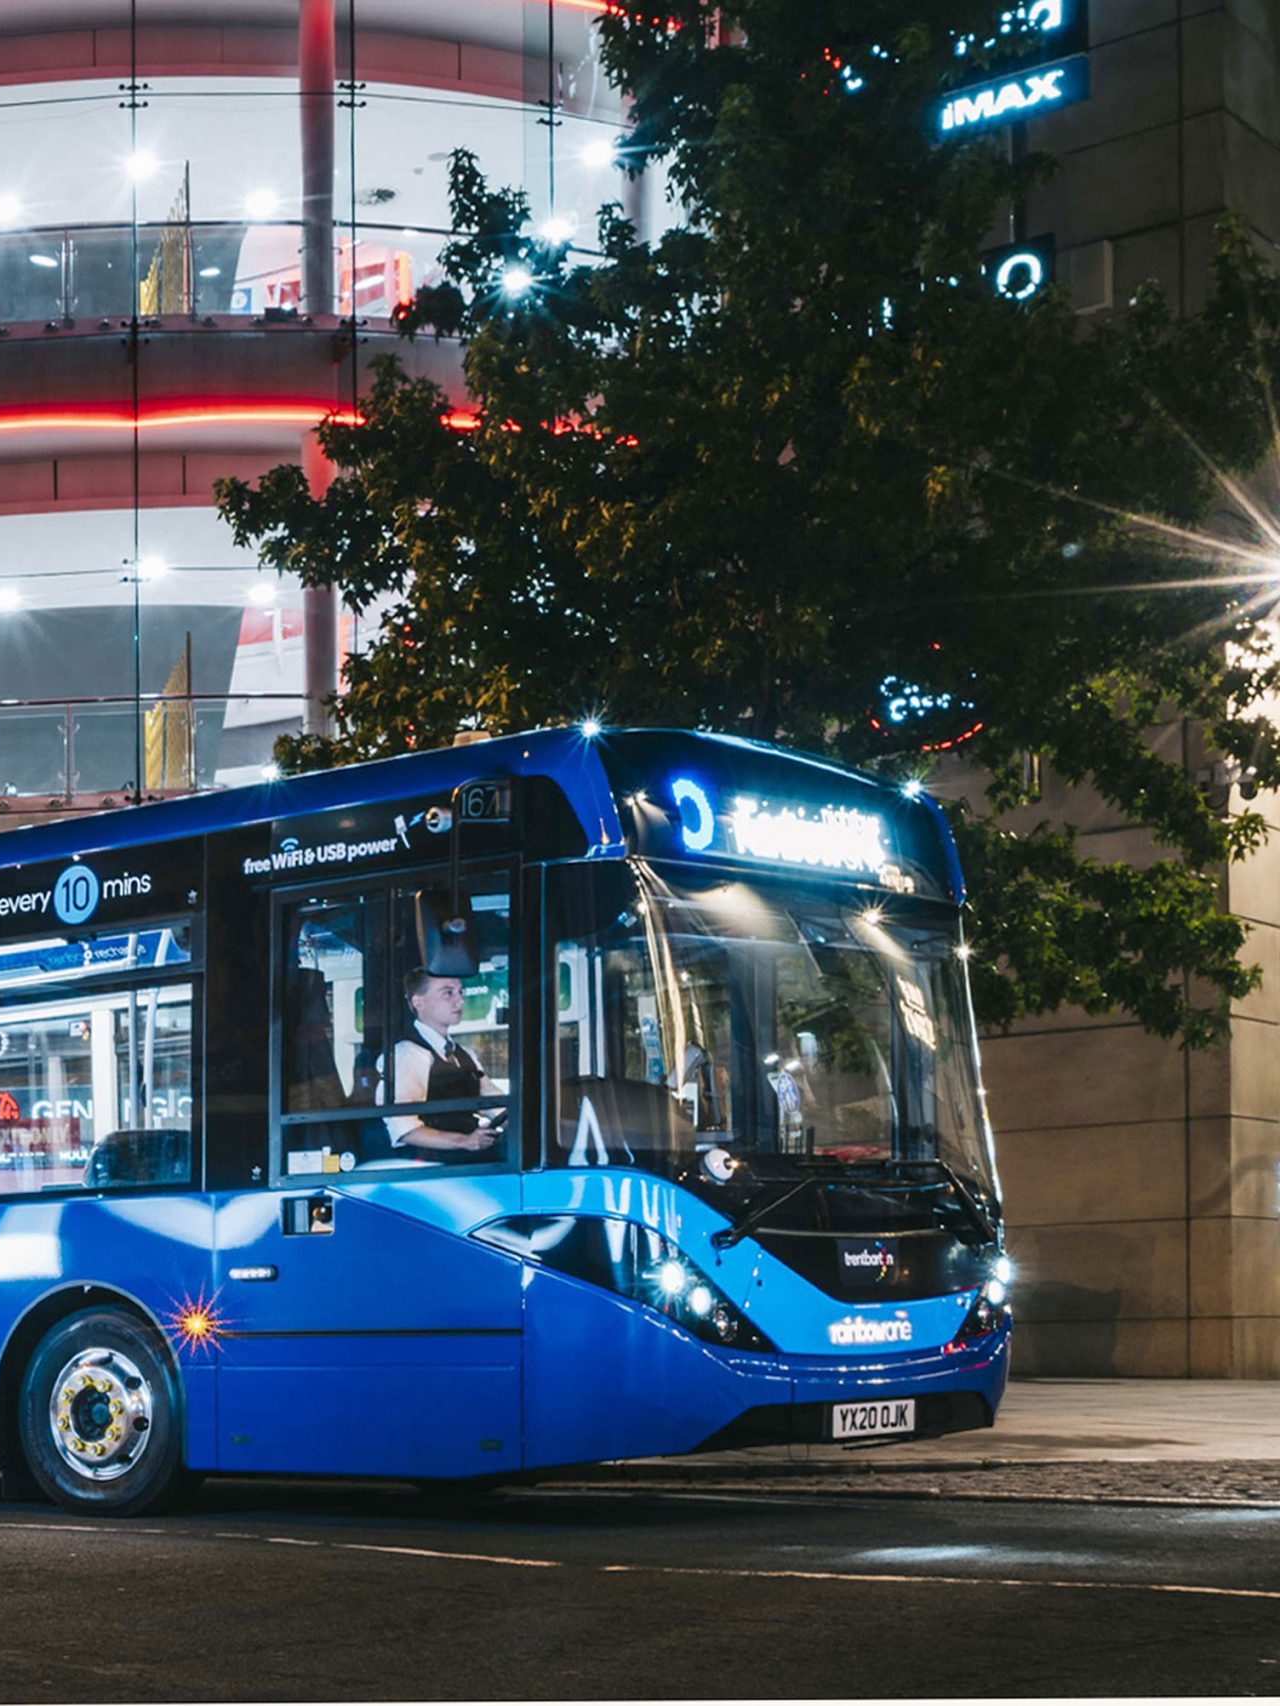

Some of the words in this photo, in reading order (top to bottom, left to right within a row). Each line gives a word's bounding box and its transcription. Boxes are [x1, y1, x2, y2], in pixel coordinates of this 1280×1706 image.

[243, 858, 271, 875] free
[271, 849, 304, 870] WiFi
[304, 848, 316, 865] &
[317, 842, 346, 863] USB
[346, 838, 398, 863] power
[62, 876, 90, 913] 10
[103, 872, 152, 899] mins
[840, 1406, 878, 1433] YX20
[881, 1403, 909, 1429] OJK
